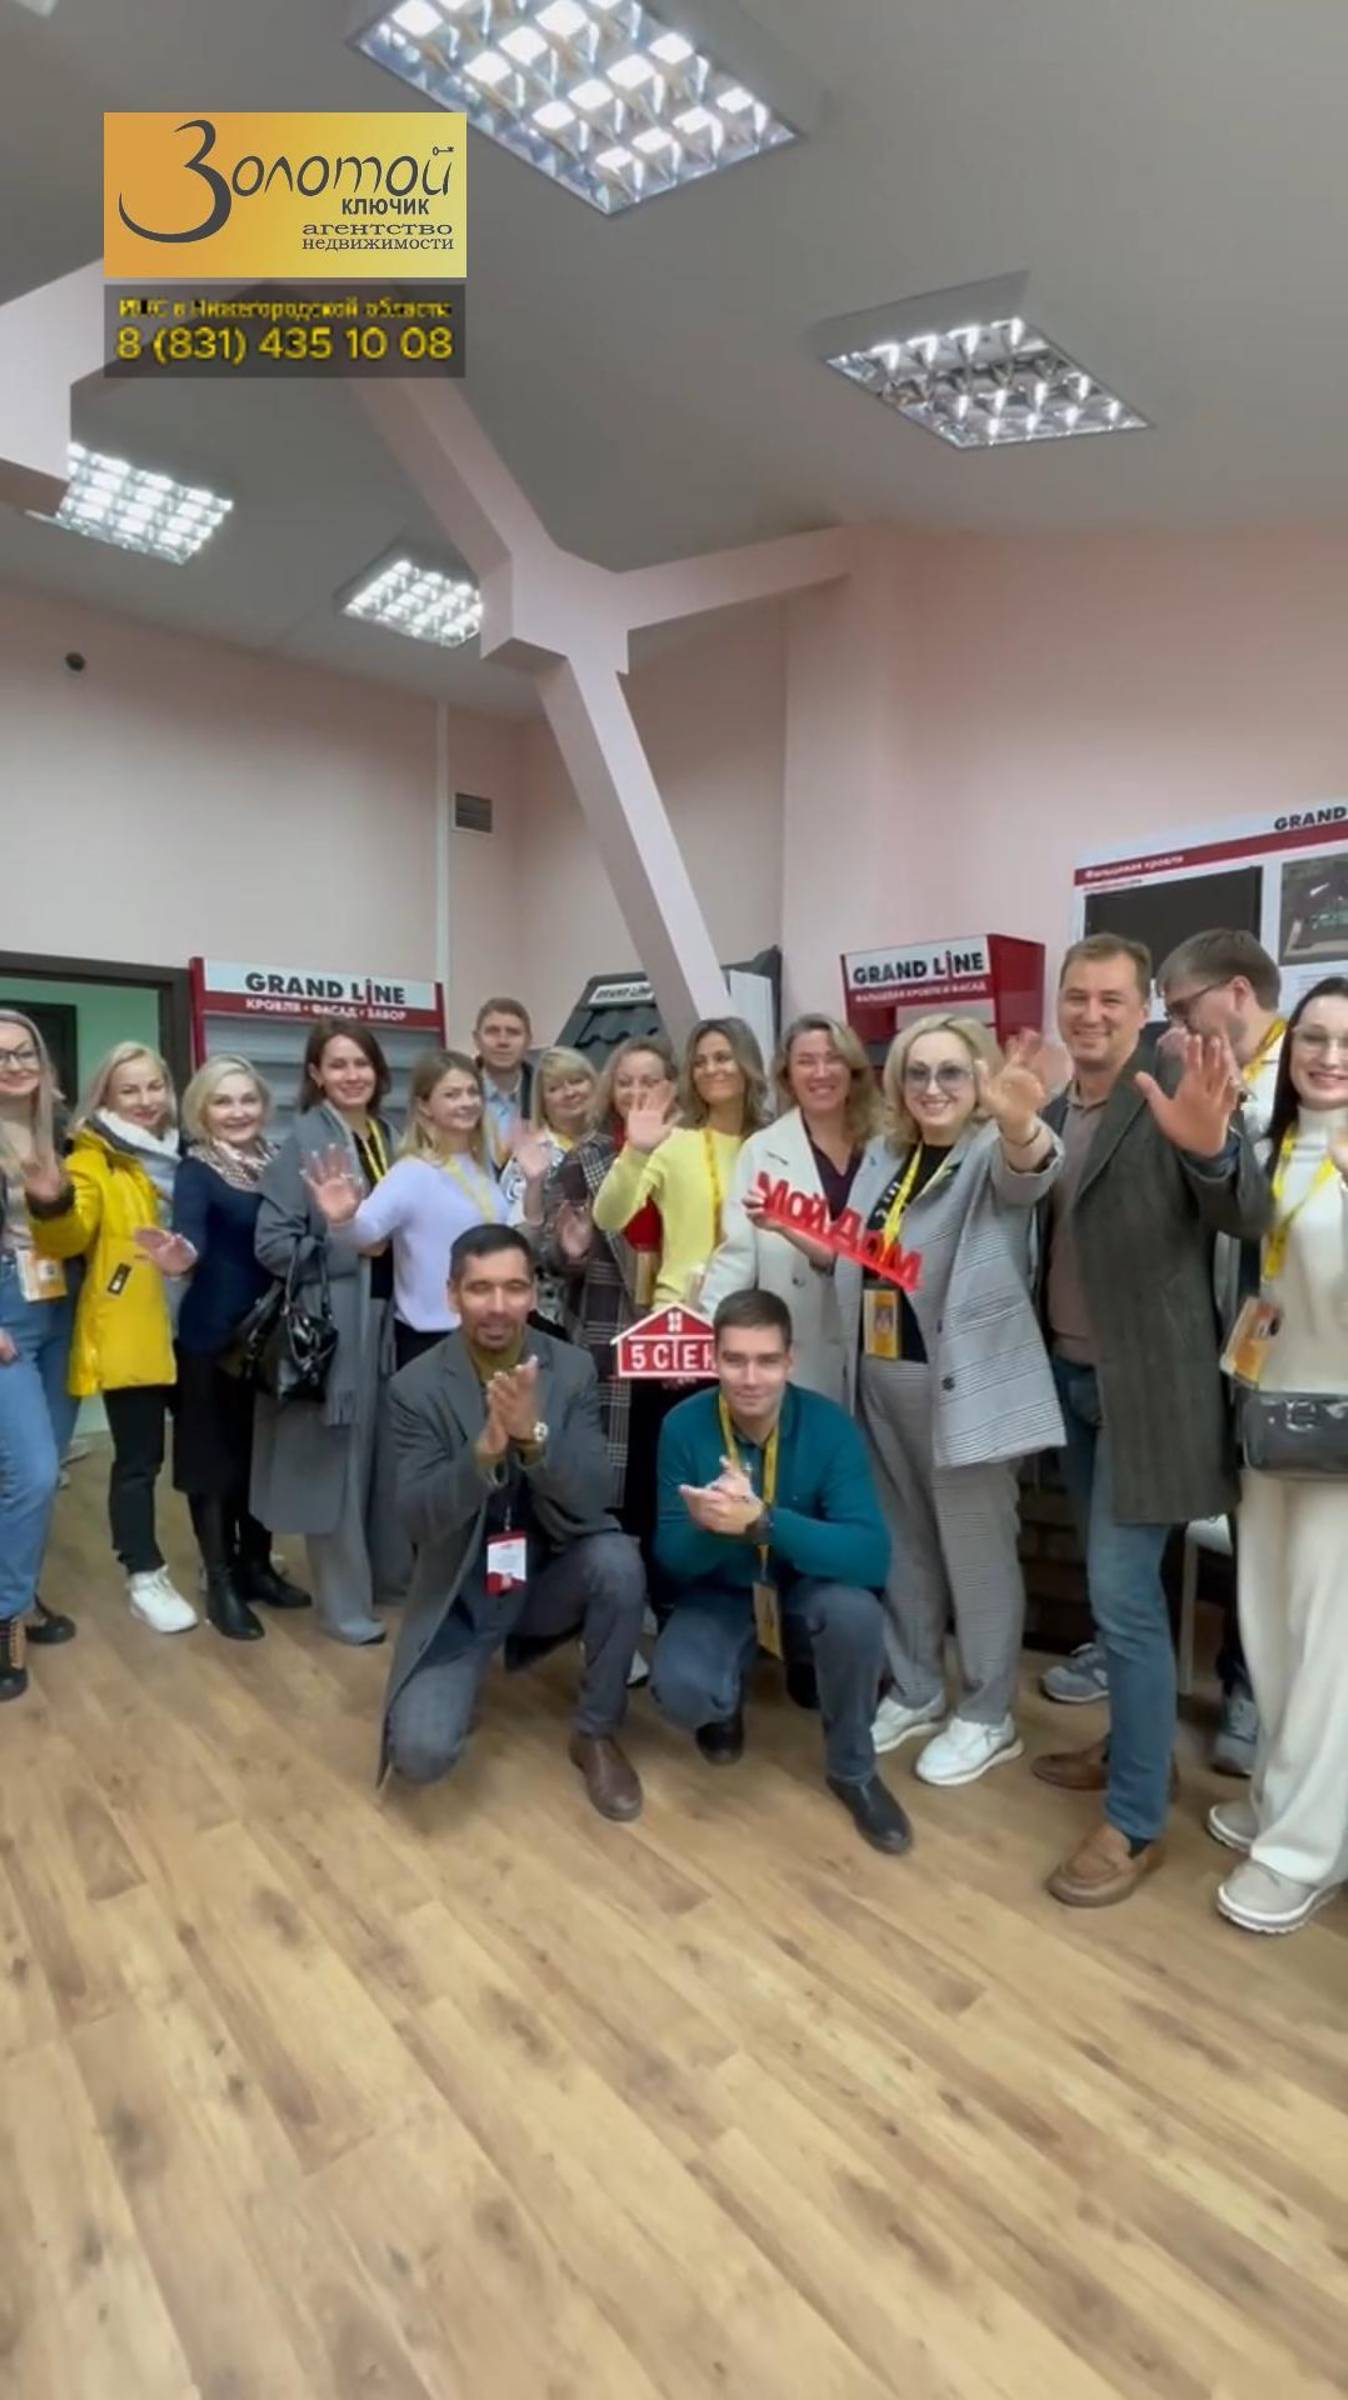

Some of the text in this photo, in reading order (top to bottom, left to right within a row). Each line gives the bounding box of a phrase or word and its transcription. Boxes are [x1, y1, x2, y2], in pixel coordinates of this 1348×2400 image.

[1274, 806, 1347, 831] GRAND
[245, 972, 344, 998] GRAND
[853, 960, 927, 985] GRAND
[246, 999, 301, 1014] КРОВЛЯ
[312, 1004, 358, 1020] ФАСАД
[630, 1342, 647, 1370] 5
